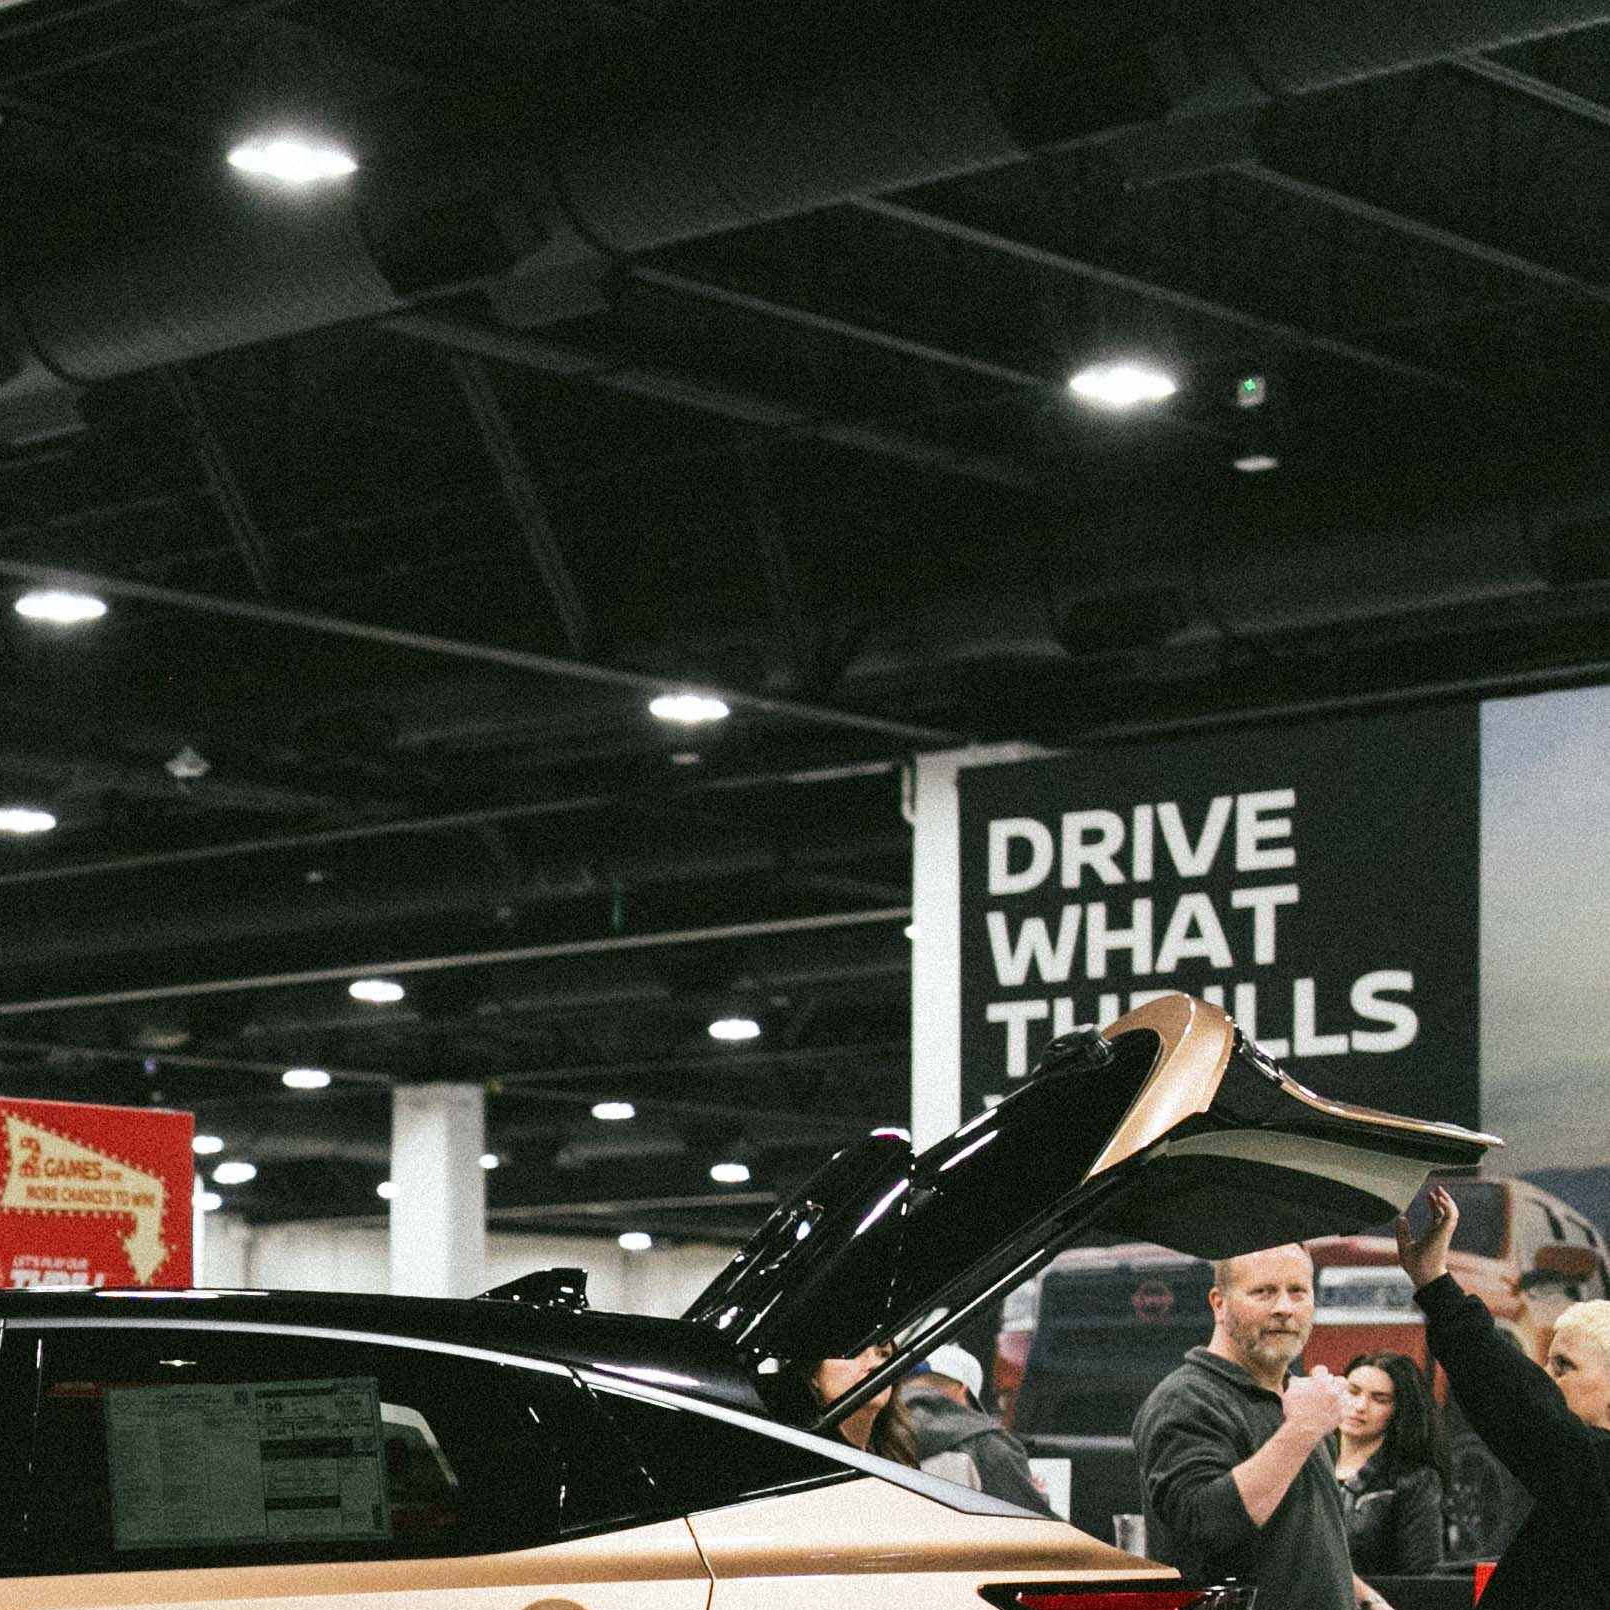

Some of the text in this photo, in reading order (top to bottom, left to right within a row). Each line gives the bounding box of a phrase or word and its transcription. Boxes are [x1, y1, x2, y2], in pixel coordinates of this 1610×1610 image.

[986, 788, 1298, 897] DRIVE
[985, 883, 1300, 988] WHAT
[985, 969, 1420, 1079] THLLS
[20, 1136, 42, 1179] 2
[43, 1157, 103, 1181] GAMES
